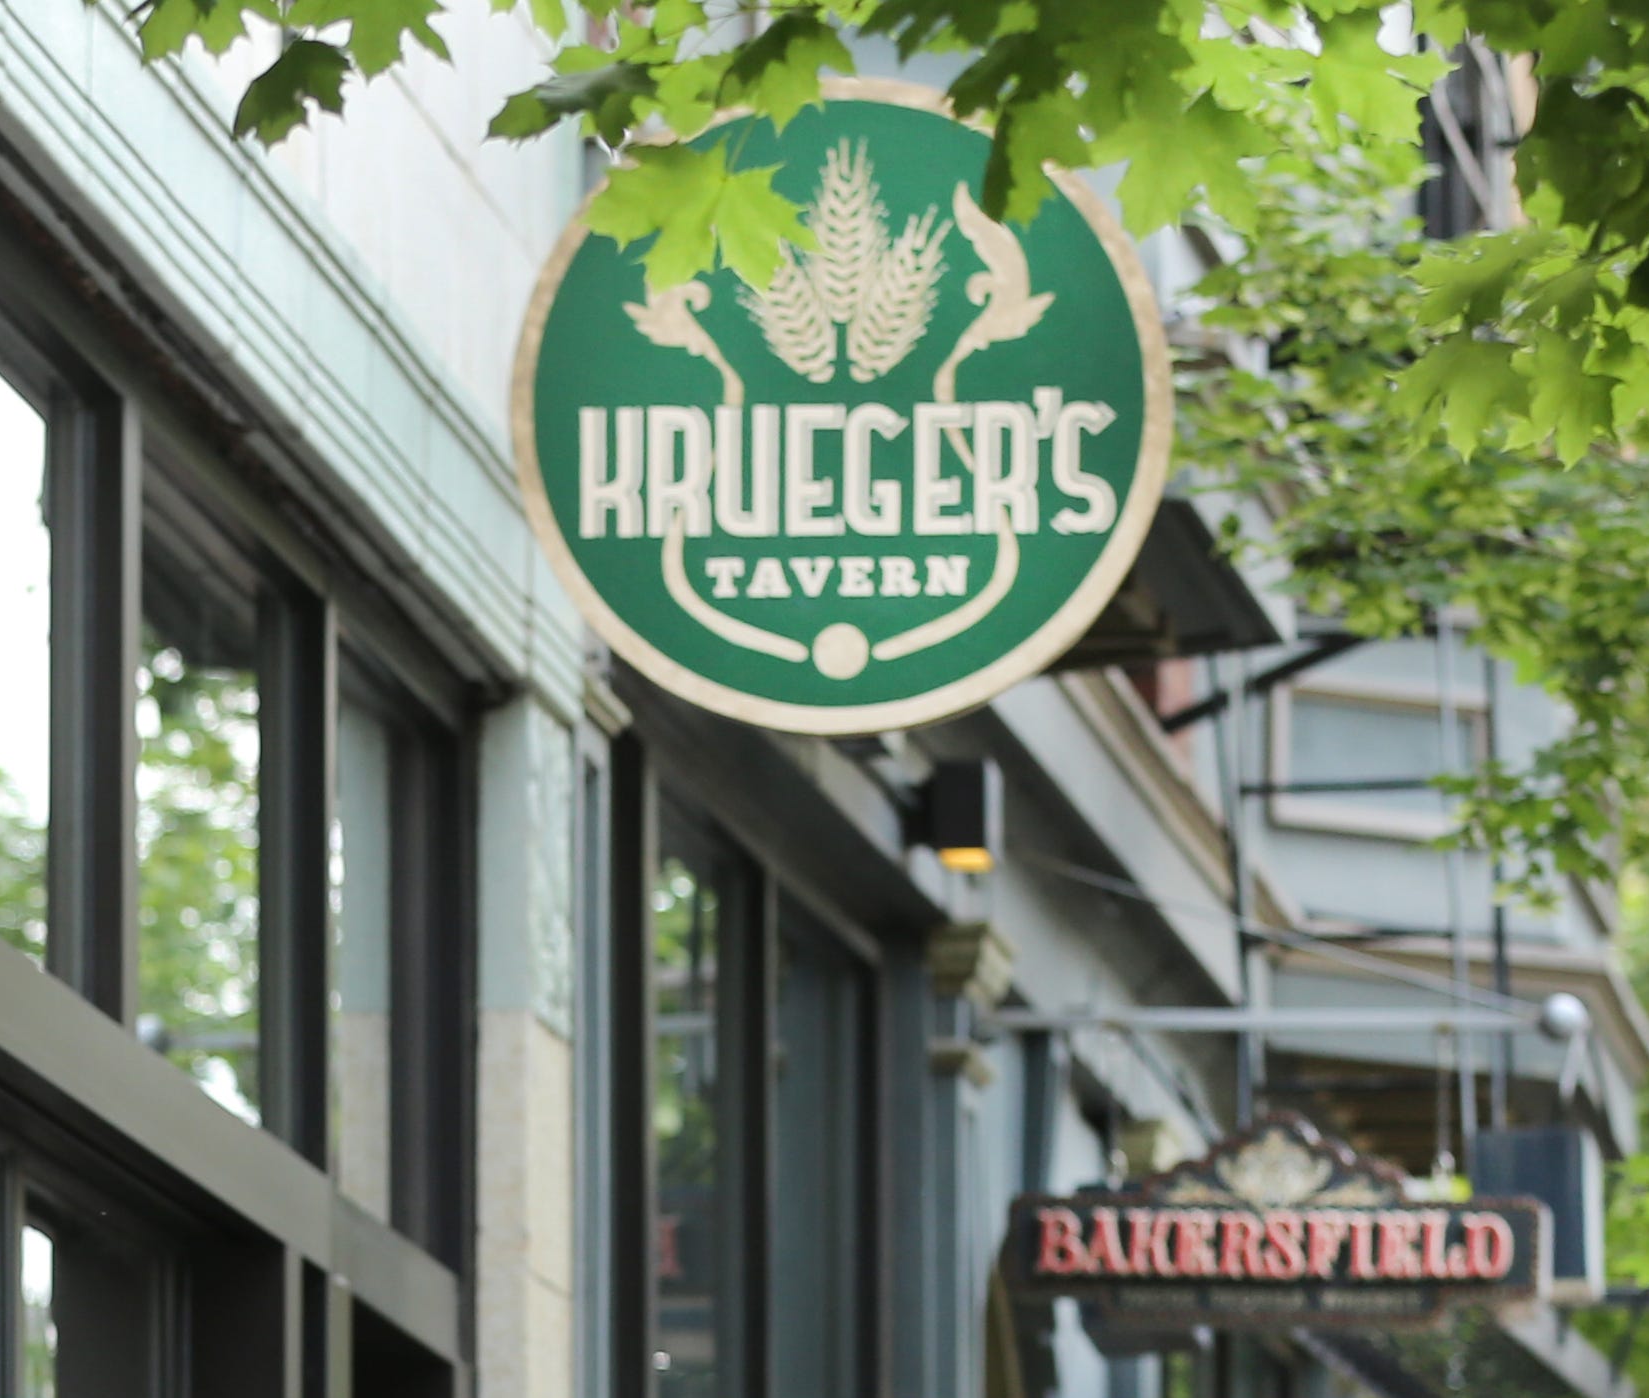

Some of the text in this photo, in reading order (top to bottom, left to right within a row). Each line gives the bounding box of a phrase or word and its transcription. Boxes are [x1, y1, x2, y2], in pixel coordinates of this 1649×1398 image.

[578, 386, 1118, 539] KRUEGER'S
[705, 555, 971, 600] TAVERN
[1035, 1206, 1515, 1281] BAKERSFIELD
